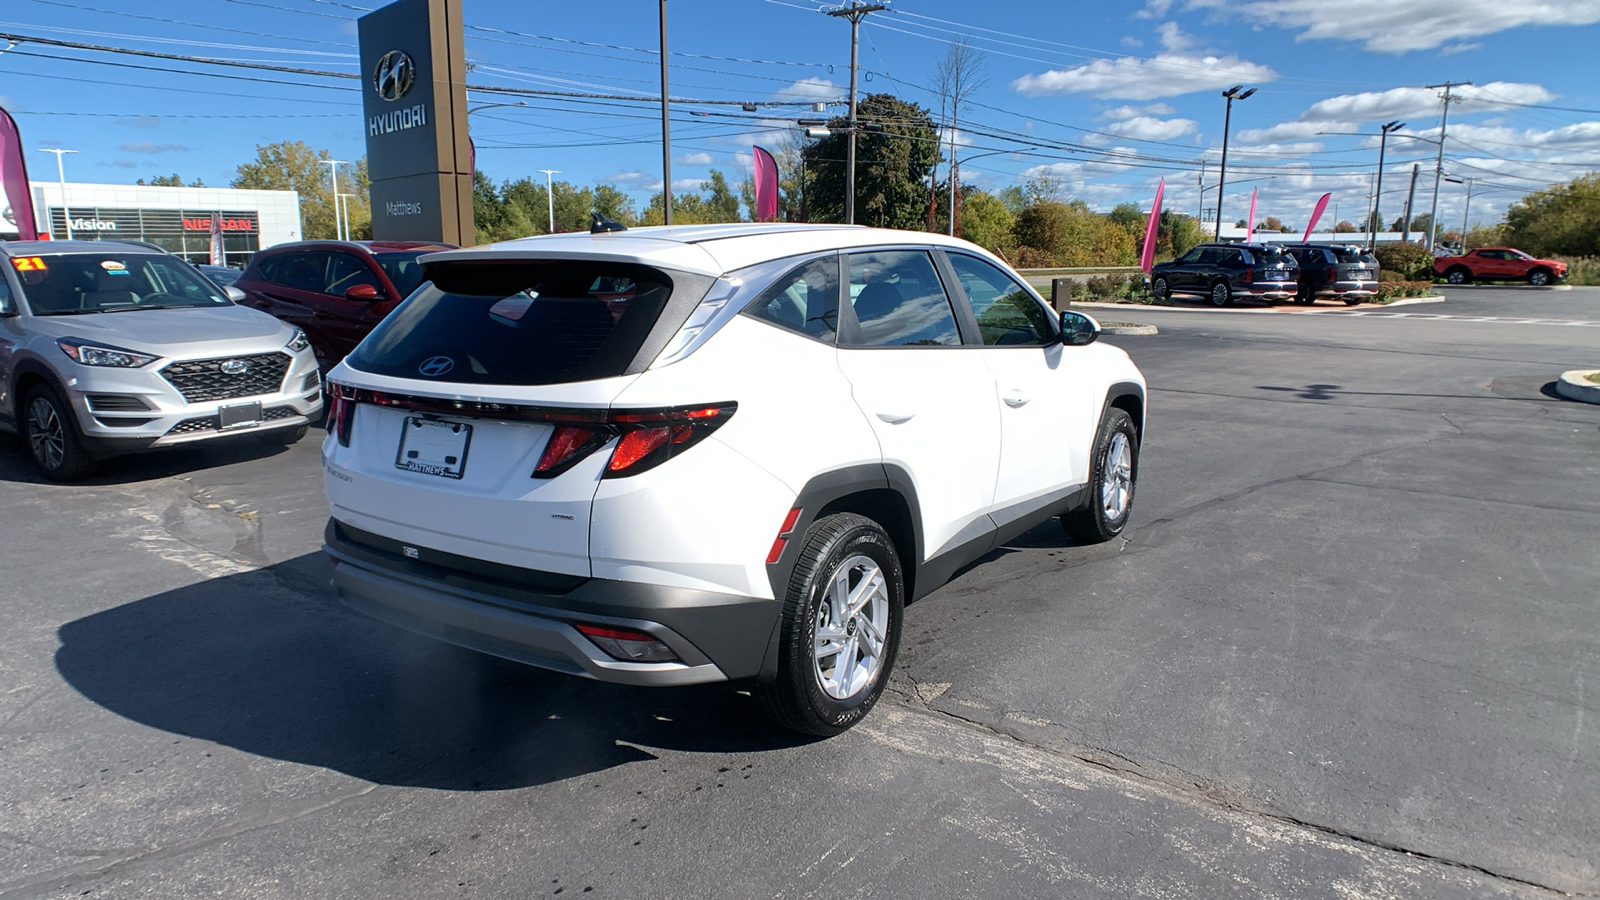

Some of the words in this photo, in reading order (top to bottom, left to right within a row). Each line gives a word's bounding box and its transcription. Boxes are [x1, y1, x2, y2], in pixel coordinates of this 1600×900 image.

[369, 103, 427, 137] HYUNDAI
[386, 201, 421, 216] Matthews
[69, 218, 116, 230] Vision
[14, 257, 46, 270] 21
[408, 463, 445, 476] MATTHEWS
